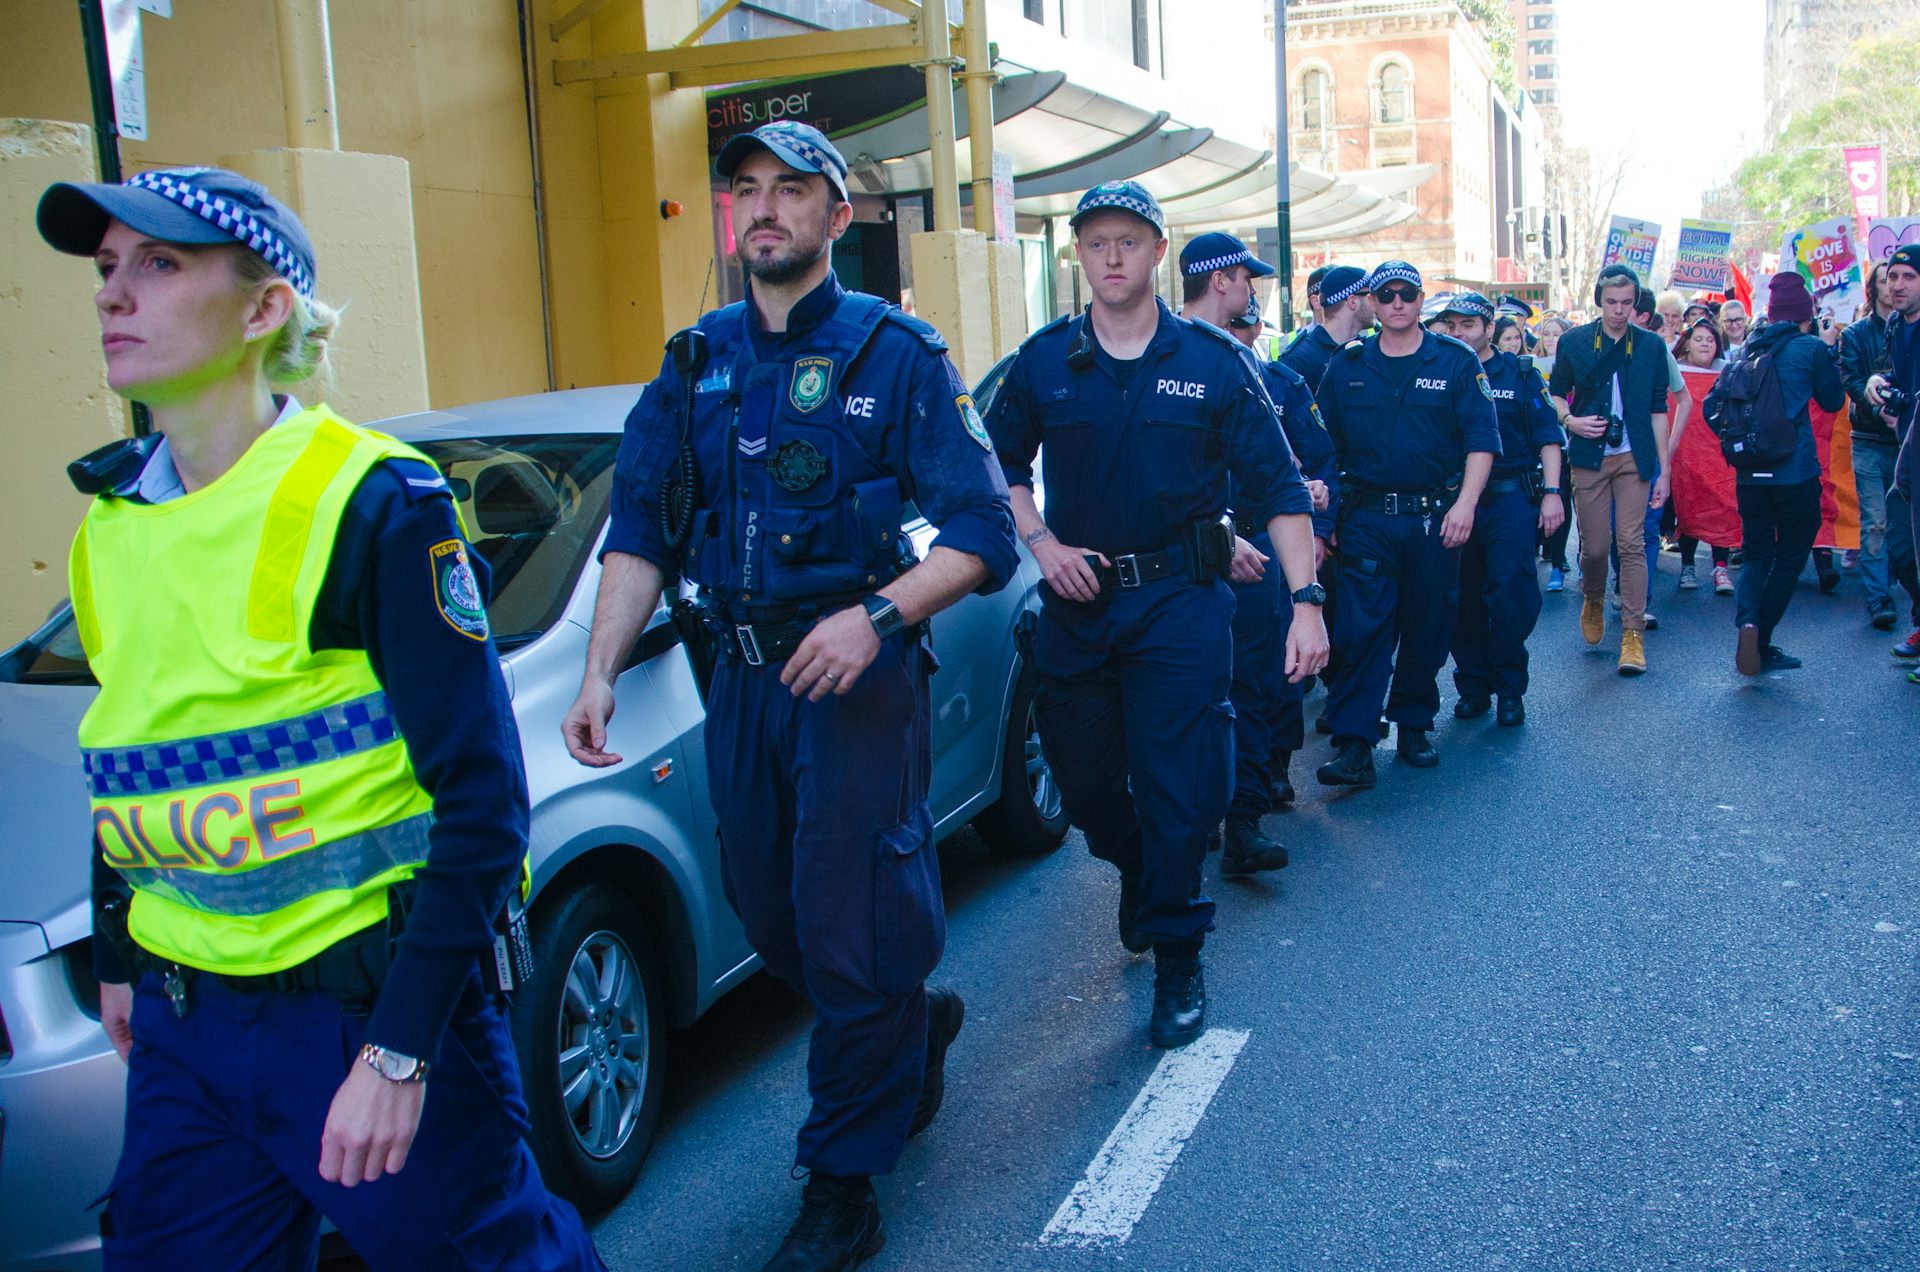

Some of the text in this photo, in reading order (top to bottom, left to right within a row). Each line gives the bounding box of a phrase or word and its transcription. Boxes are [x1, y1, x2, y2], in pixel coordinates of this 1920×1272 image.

[708, 91, 811, 128] citisuper
[1611, 232, 1655, 251] QUEER
[1684, 231, 1727, 246] EQUAL
[1608, 245, 1652, 263] PRIDE
[1681, 253, 1725, 266] RIGHTS
[1805, 240, 1844, 263] LOVE
[1680, 265, 1723, 281] NOW!
[1820, 259, 1835, 273] IS
[1810, 270, 1850, 293] LOVE
[1157, 378, 1206, 399] POLICE
[1415, 377, 1447, 391] POLICE
[1492, 389, 1515, 400] OLICE
[845, 395, 875, 419] ICE
[743, 511, 758, 588] POLICE
[92, 778, 316, 870] OLICE
